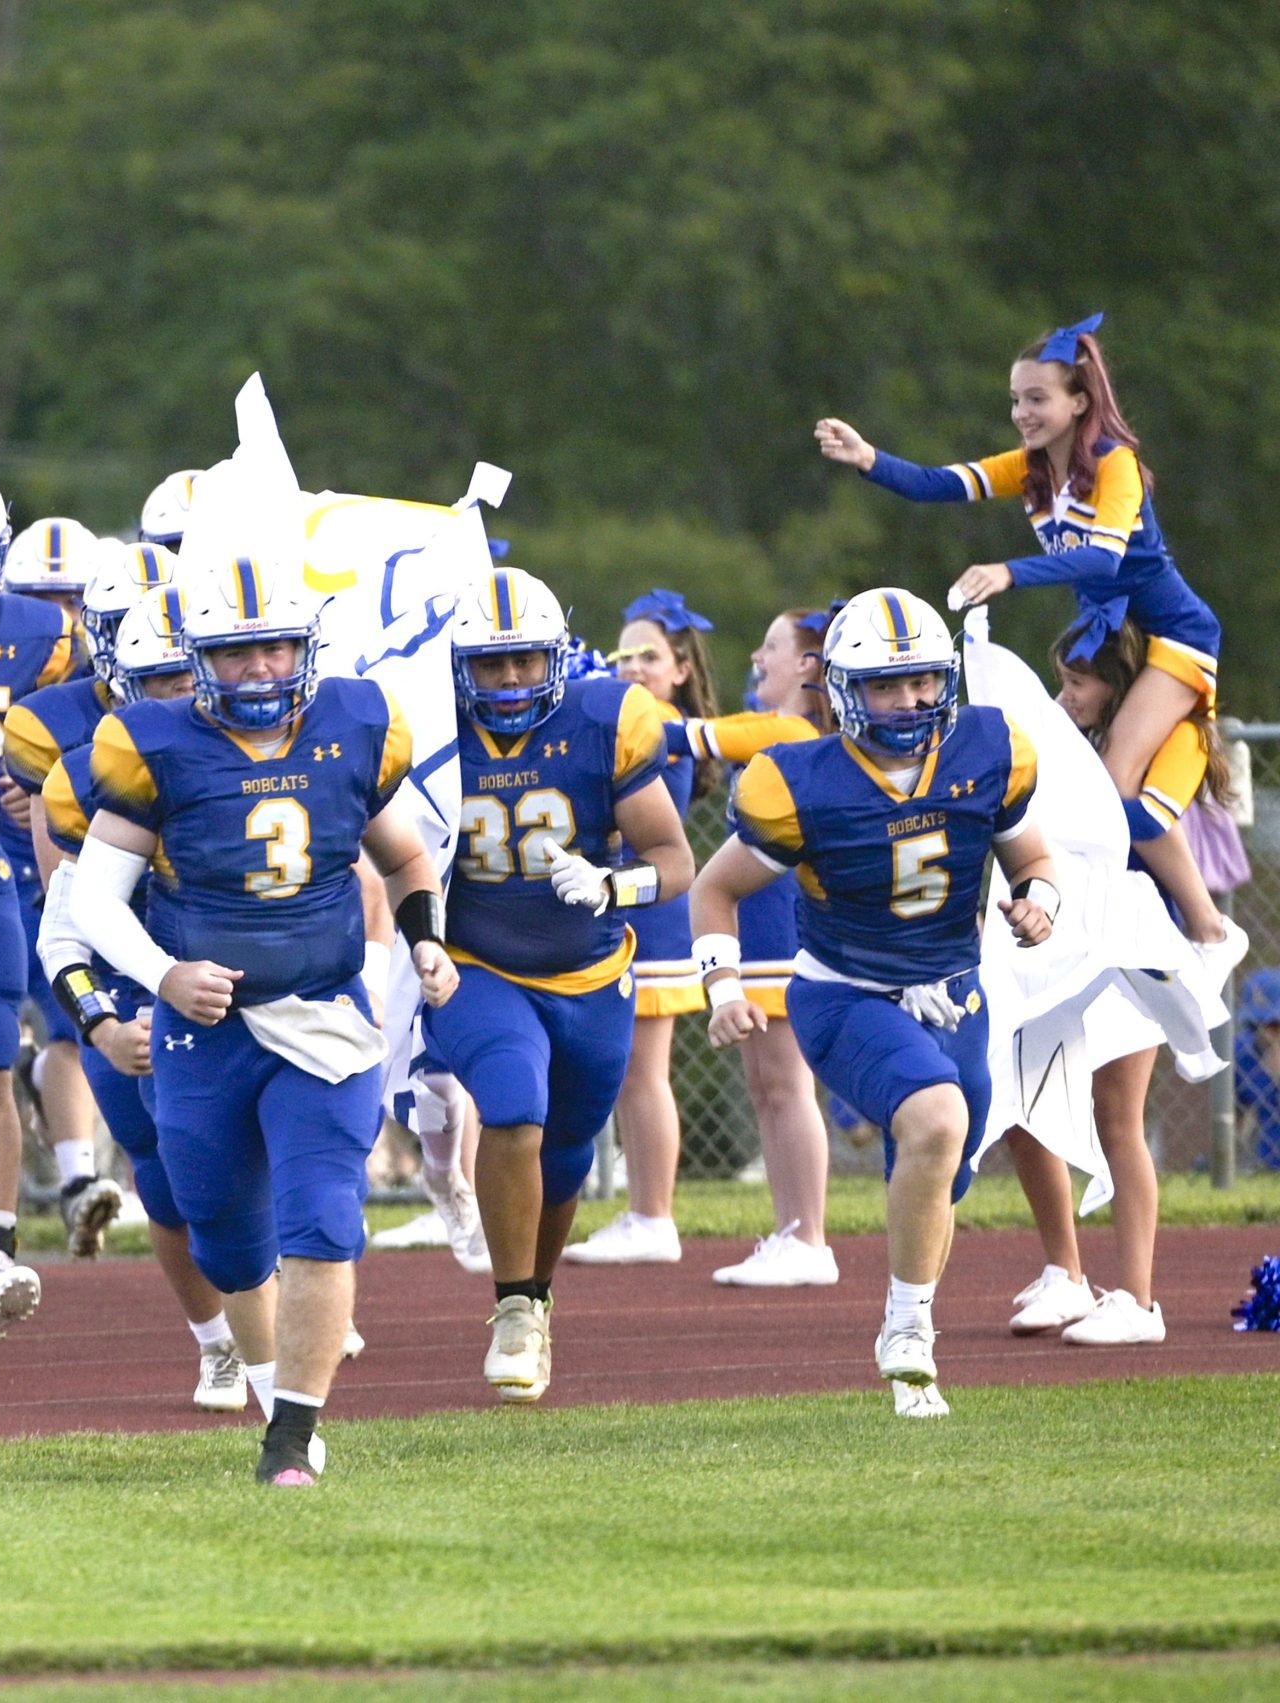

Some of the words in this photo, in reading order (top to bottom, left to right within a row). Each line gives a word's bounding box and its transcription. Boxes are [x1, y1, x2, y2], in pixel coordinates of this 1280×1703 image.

[489, 633, 523, 642] Riddell
[241, 774, 309, 794] BOBCATS
[479, 770, 539, 790] BOBCATS
[459, 787, 582, 884] 32
[886, 811, 946, 837] BOBCATS
[244, 797, 312, 900] 3
[890, 829, 950, 919] 5
